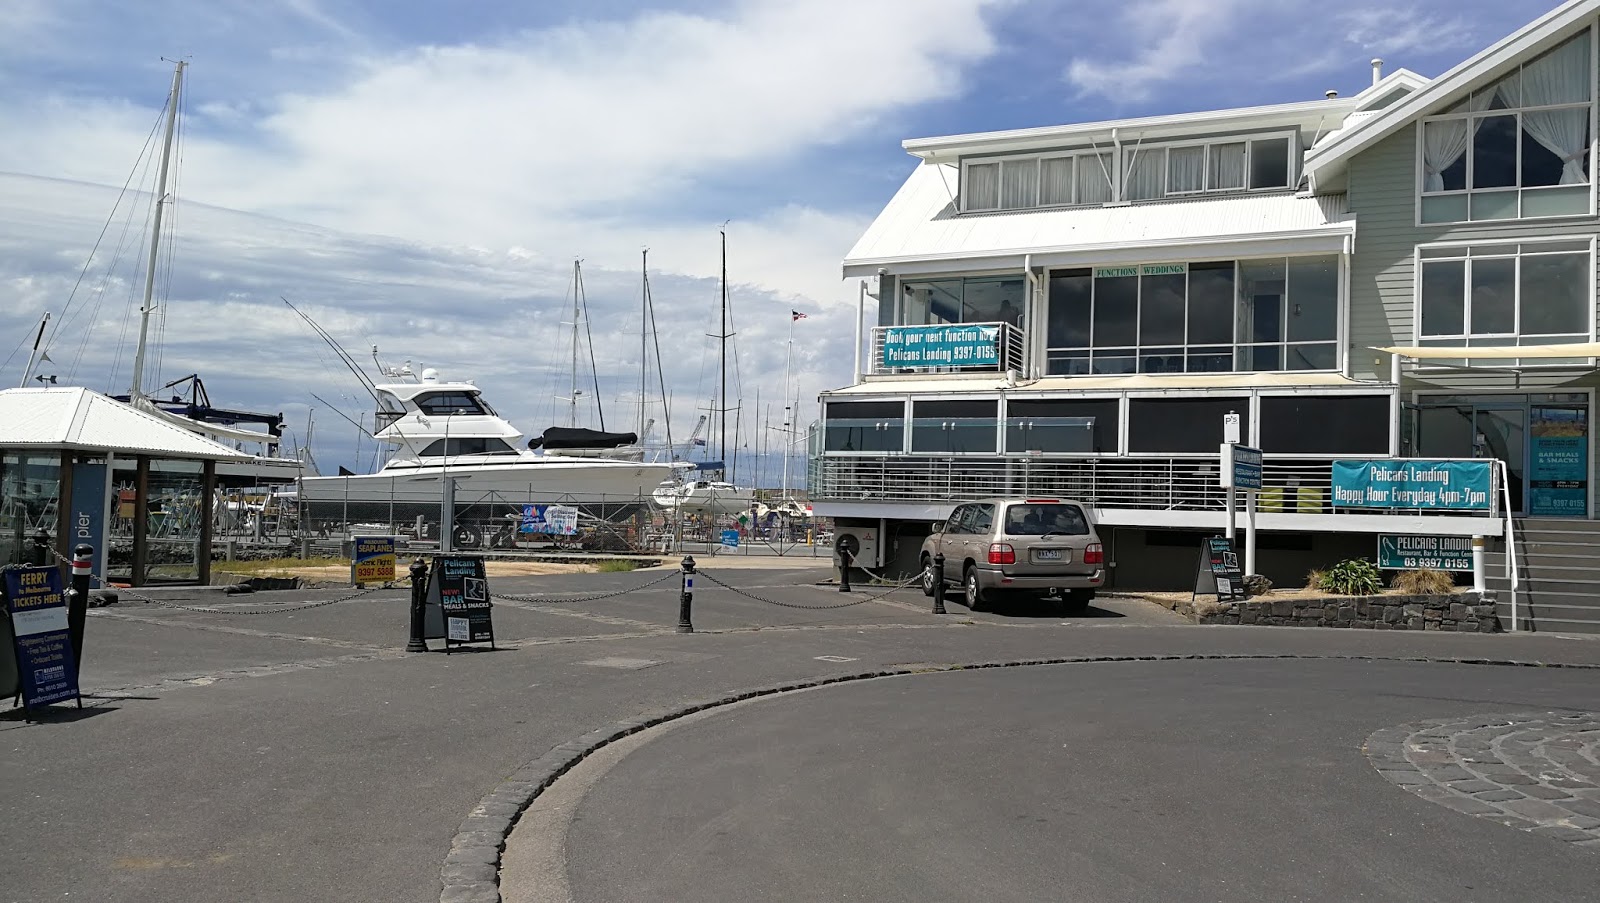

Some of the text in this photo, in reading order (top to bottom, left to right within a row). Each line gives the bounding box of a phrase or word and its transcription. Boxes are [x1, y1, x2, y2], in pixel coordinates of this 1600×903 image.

[1097, 265, 1184, 277] FUNCTIONS WEDDINGS
[886, 331, 903, 344] Book
[905, 333, 923, 346] your
[925, 331, 943, 343] next
[945, 329, 977, 342] function
[888, 345, 995, 362] Pelicans Landing 9397-0155
[1370, 466, 1449, 485] Pelicans Landing
[1335, 485, 1486, 506] Happy Hour Everyday 4pm-7pm
[1553, 499, 1568, 507] 9397
[75, 512, 92, 538] pier
[358, 544, 394, 553] SEAPLANES
[1397, 536, 1437, 550] PELICANS
[376, 558, 392, 567] Flights
[1404, 557, 1469, 568] 03 9397 0155
[358, 568, 375, 577] 9397
[445, 567, 476, 577] Landing
[20, 571, 48, 586] FERRY
[25, 586, 52, 594] Melbourne
[13, 593, 62, 608] TICKETS HERE
[443, 595, 465, 604] BAR
